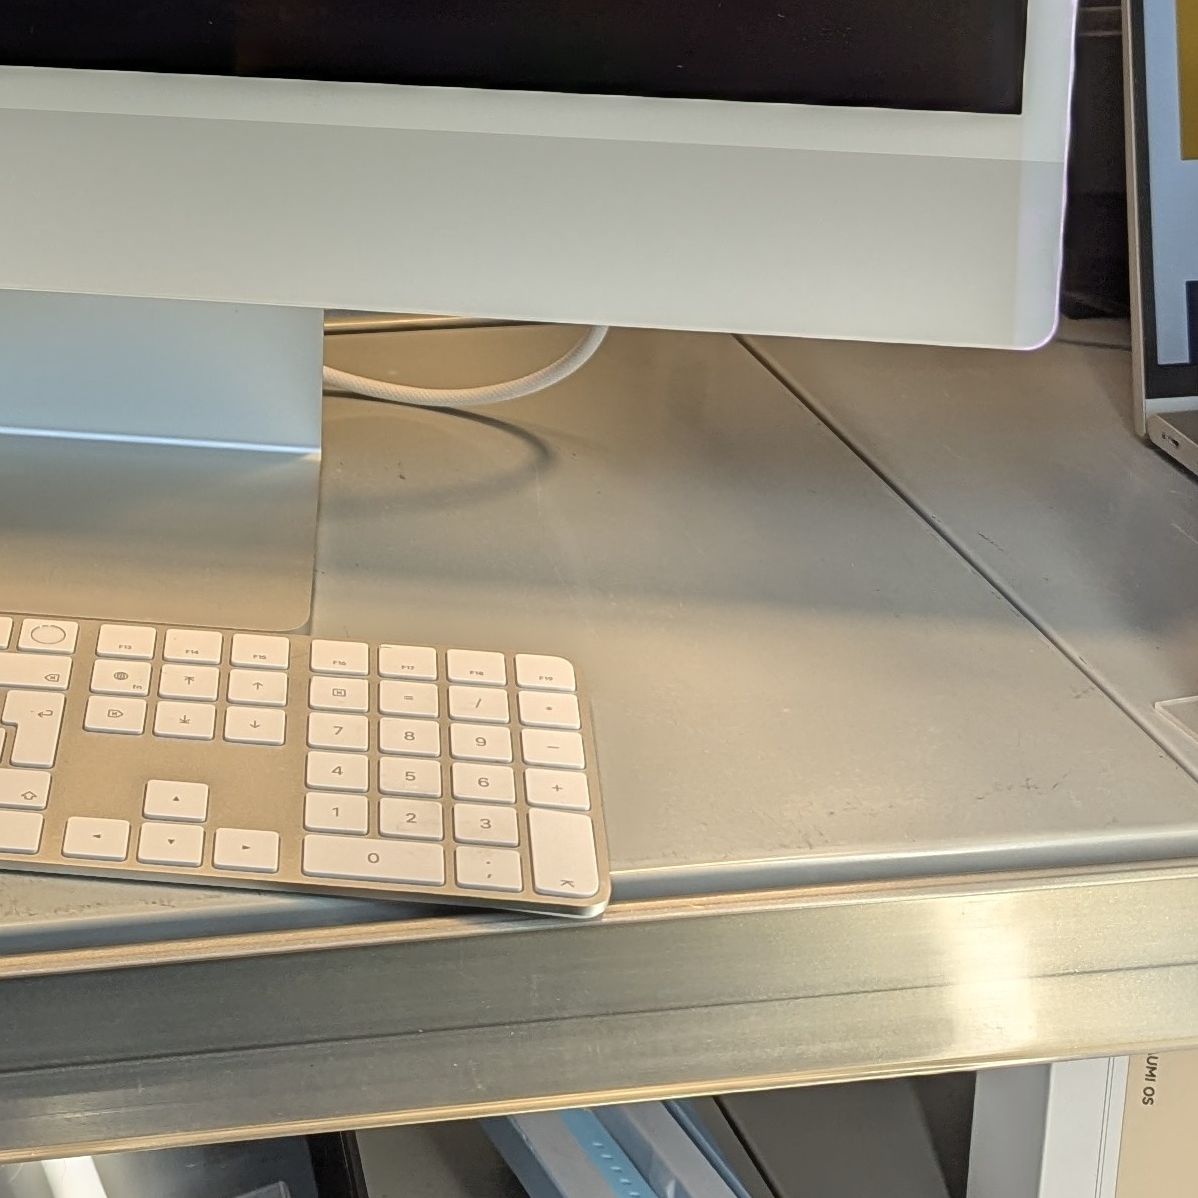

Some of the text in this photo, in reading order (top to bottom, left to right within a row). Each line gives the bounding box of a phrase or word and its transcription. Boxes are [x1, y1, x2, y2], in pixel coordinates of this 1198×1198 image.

[334, 726, 343, 735] 7
[404, 731, 415, 740] 8
[476, 737, 486, 746] 9
[332, 766, 343, 775] 4
[406, 771, 415, 781] 5
[478, 778, 489, 787] 6
[333, 807, 338, 817] 1
[406, 813, 417, 823] 2
[480, 819, 491, 829] 3
[368, 853, 379, 863] 0
[1142, 1053, 1158, 1105] UMI OS
